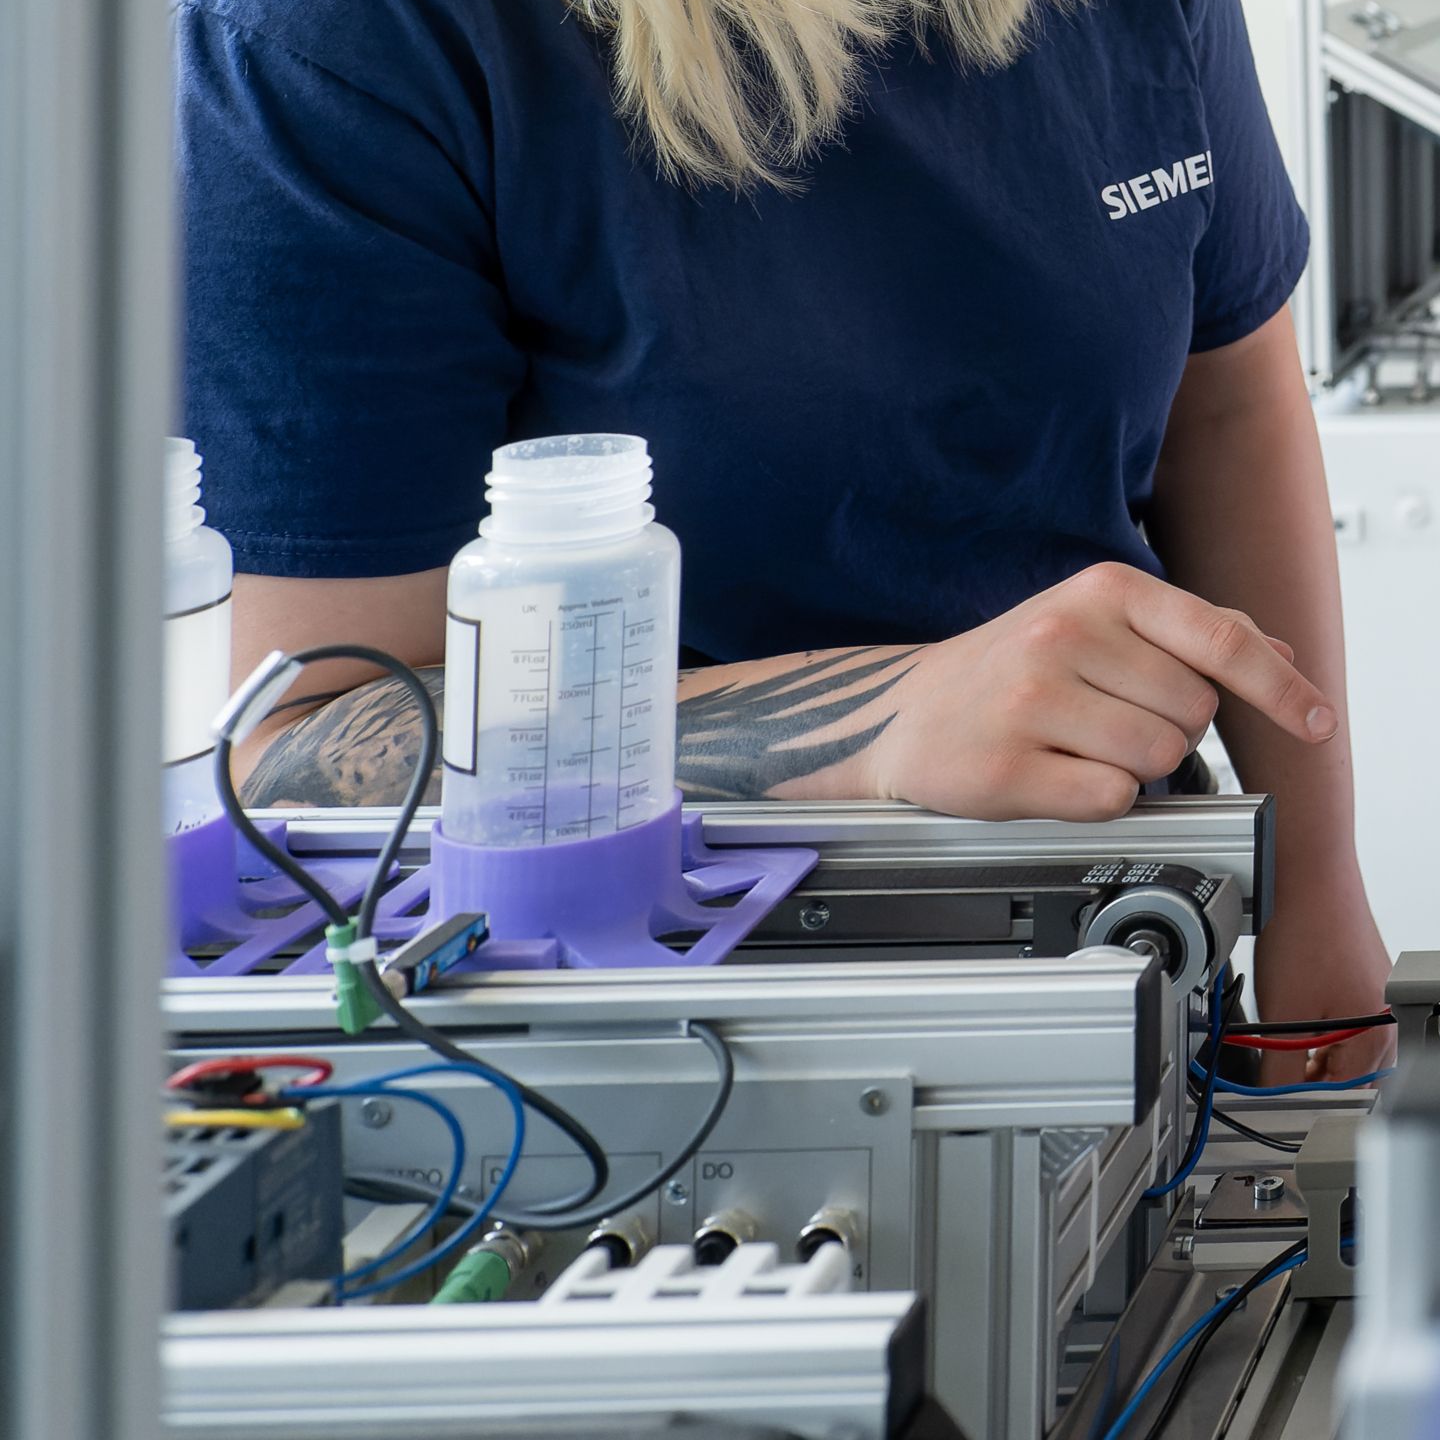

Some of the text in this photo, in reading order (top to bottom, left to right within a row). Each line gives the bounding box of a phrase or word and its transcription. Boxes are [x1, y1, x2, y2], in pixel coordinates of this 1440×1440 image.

[1101, 149, 1214, 221] SIEME
[521, 604, 537, 614] UK
[702, 1162, 734, 1180] DO
